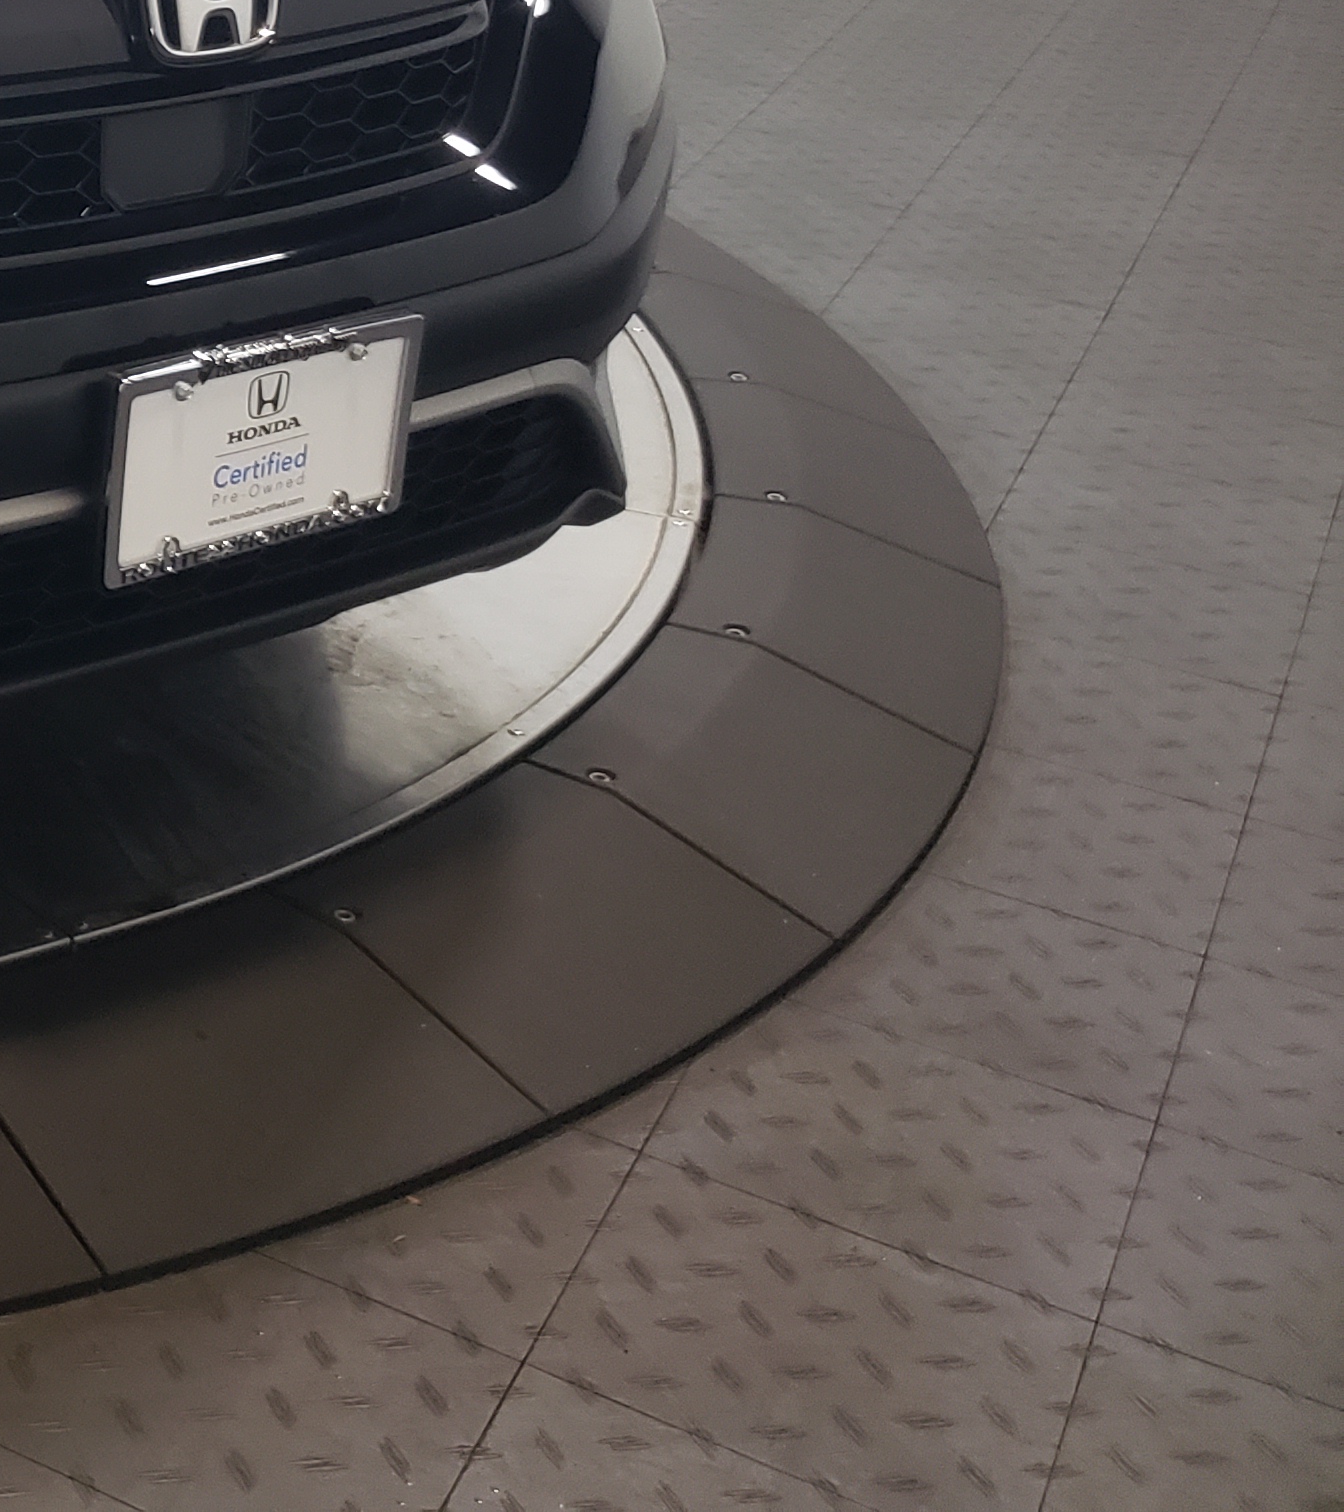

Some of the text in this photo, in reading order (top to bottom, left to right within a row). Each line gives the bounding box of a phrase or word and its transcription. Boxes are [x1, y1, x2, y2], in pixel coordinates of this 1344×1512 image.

[227, 417, 301, 445] HONDA
[214, 444, 308, 489] Certified
[212, 474, 306, 507] Pre-Owned
